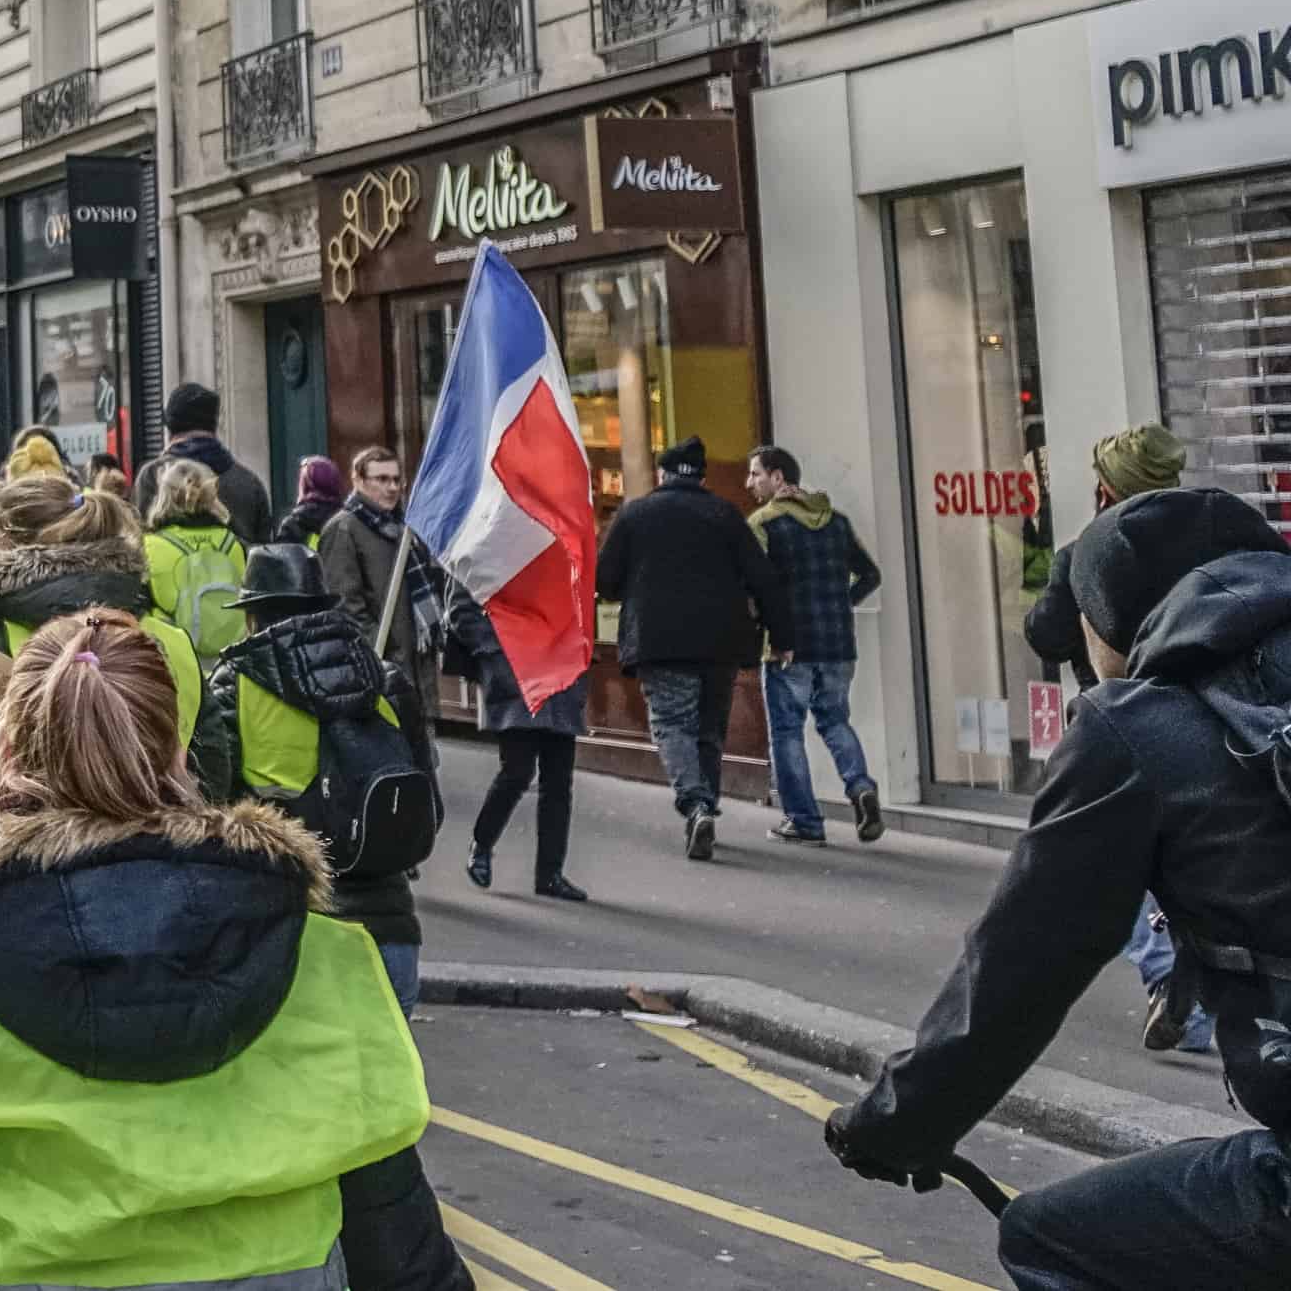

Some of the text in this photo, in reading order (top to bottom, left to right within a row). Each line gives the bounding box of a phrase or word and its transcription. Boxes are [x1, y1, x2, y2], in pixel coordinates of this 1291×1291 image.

[612, 156, 722, 191] Melvita
[77, 206, 137, 222] OYSHO
[428, 153, 567, 241] Melvita
[934, 471, 1036, 516] SOLDES
